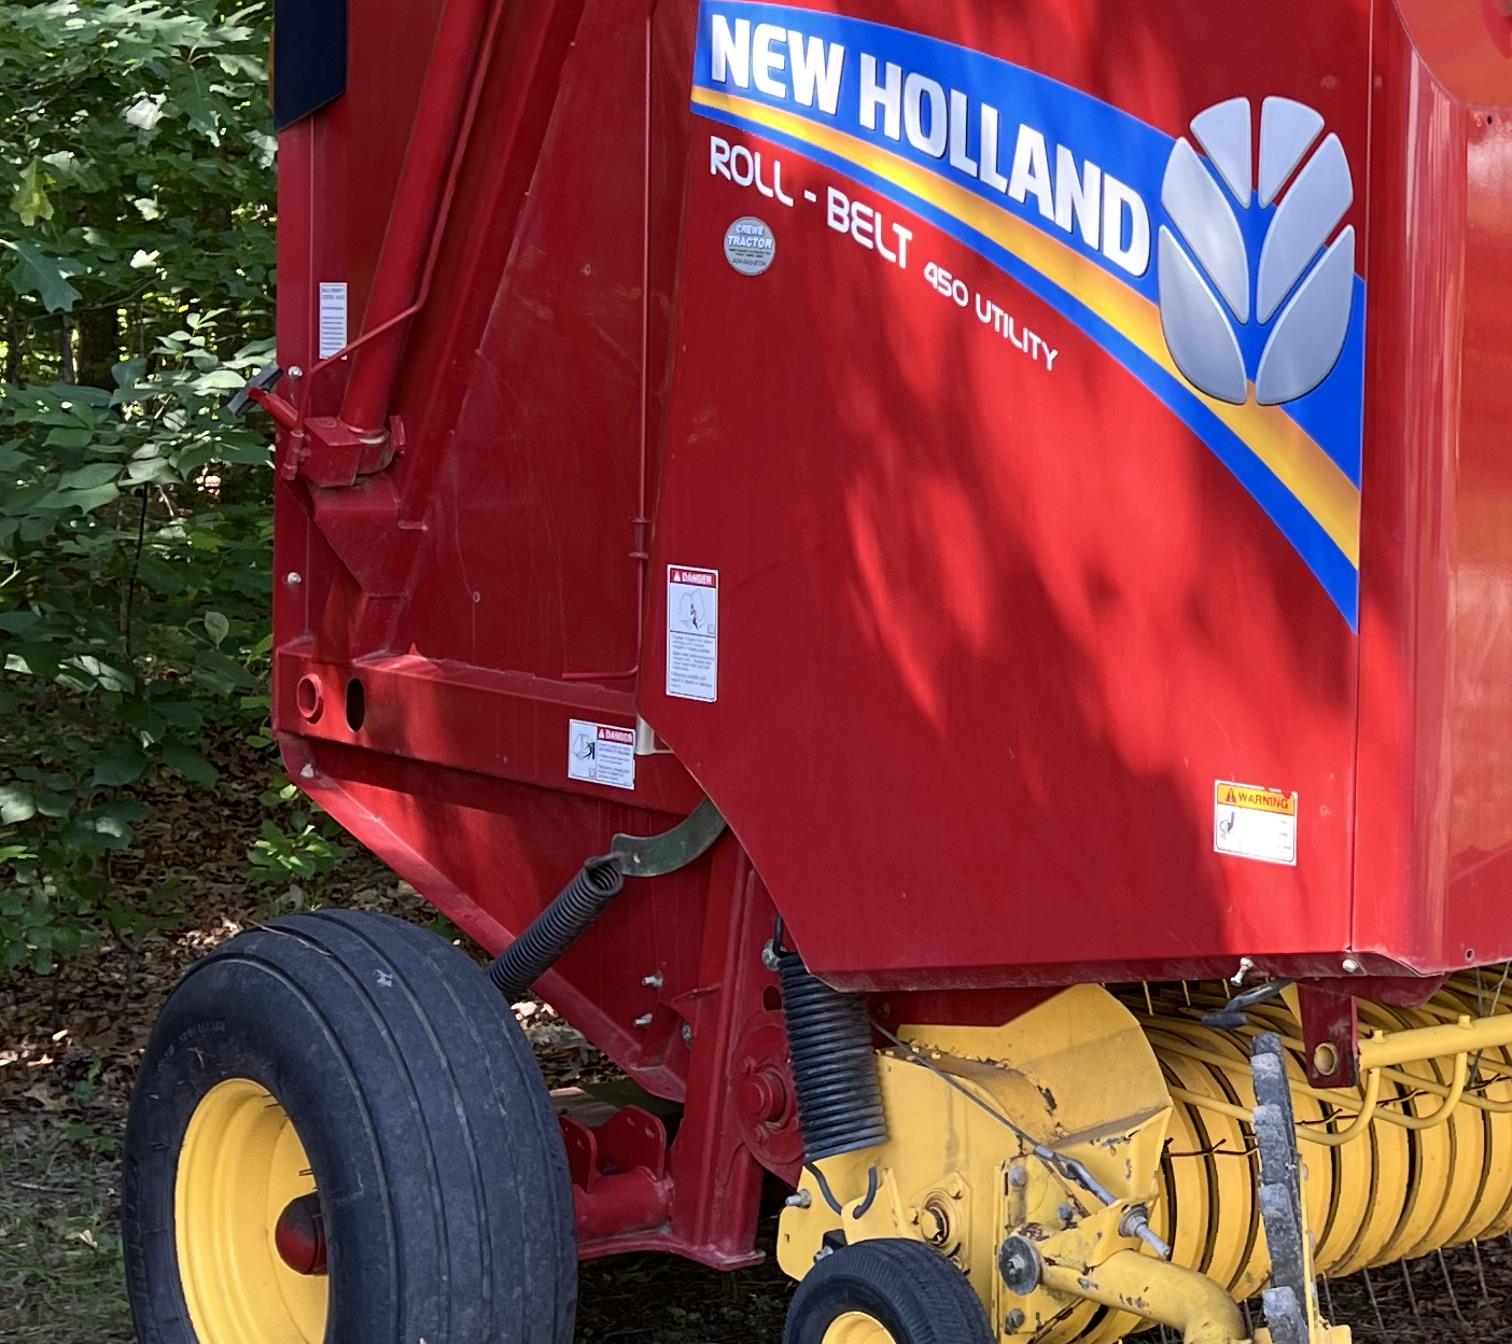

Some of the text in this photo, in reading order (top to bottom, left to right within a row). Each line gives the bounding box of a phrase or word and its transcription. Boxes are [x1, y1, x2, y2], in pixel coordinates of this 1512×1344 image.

[711, 13, 1150, 278] NEW HOLLAND
[710, 135, 794, 208] ROLL
[826, 185, 913, 270] BELT
[923, 262, 969, 308] 450
[974, 296, 1059, 372] UTILITY
[728, 235, 772, 249] TRACTOR
[1238, 791, 1289, 810] WARNING
